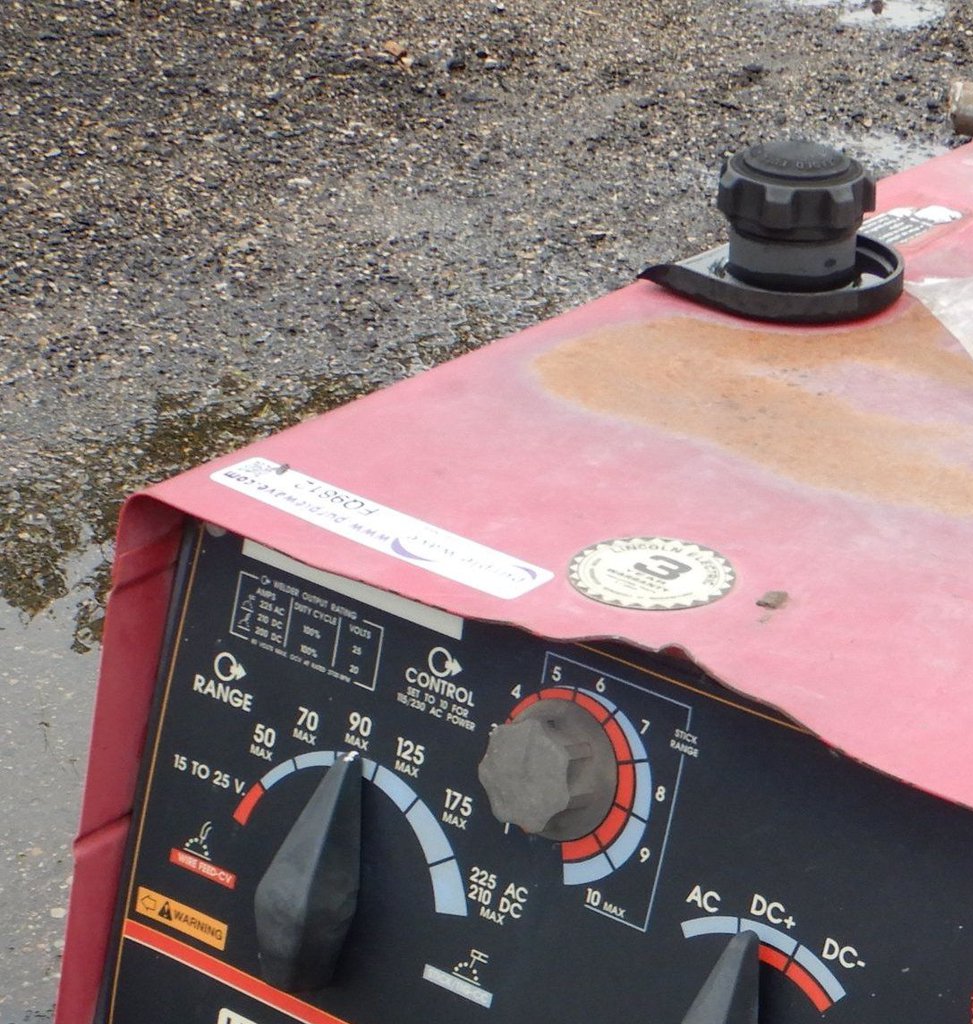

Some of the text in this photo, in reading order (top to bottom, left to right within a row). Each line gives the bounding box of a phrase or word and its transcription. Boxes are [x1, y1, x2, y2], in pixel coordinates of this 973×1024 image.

[633, 554, 692, 580] 3
[256, 587, 276, 601] AMPS
[273, 580, 357, 620] WELDER OUTPUT RATING
[258, 600, 286, 616] 225 AC
[293, 602, 338, 626] DUTY CYCLE
[256, 613, 283, 629] 210 DC
[270, 632, 283, 643] DC
[302, 625, 321, 639] 100%
[349, 624, 372, 639] VOLTS
[300, 644, 318, 659] 100%
[351, 645, 362, 656] 25
[349, 664, 359, 675] 20
[551, 666, 562, 682] 5
[193, 674, 253, 713] RANGE
[405, 667, 475, 708] CONTROL
[511, 684, 521, 700] 4
[596, 677, 606, 693] 6
[407, 686, 469, 718] SET TO 10 FOR
[298, 707, 319, 732] 70
[397, 692, 476, 732] 115/230 AC POWER
[349, 712, 372, 737] 90
[640, 719, 650, 735] 7
[253, 723, 276, 748] 50
[293, 728, 317, 746] MAX
[344, 733, 369, 751] MAX
[674, 728, 698, 744] STICK
[250, 744, 272, 762] MAX
[397, 737, 425, 765] 125
[670, 739, 699, 758] RANGE
[173, 754, 187, 772] 15
[191, 760, 209, 780] TO
[214, 770, 230, 789] 25
[395, 760, 419, 778] MAX
[444, 788, 472, 816] 175
[655, 786, 666, 802] 8
[442, 812, 467, 830] MAX
[178, 853, 199, 870] WIRE
[639, 847, 650, 864] 9
[469, 866, 529, 903] 225 AC
[468, 884, 523, 919] 210 DC
[585, 888, 625, 919] 10 MAX
[687, 885, 721, 914] AC
[480, 906, 505, 926] MAX
[749, 894, 797, 930] DC+
[174, 907, 223, 942] WARNING
[822, 937, 866, 970] DC-
